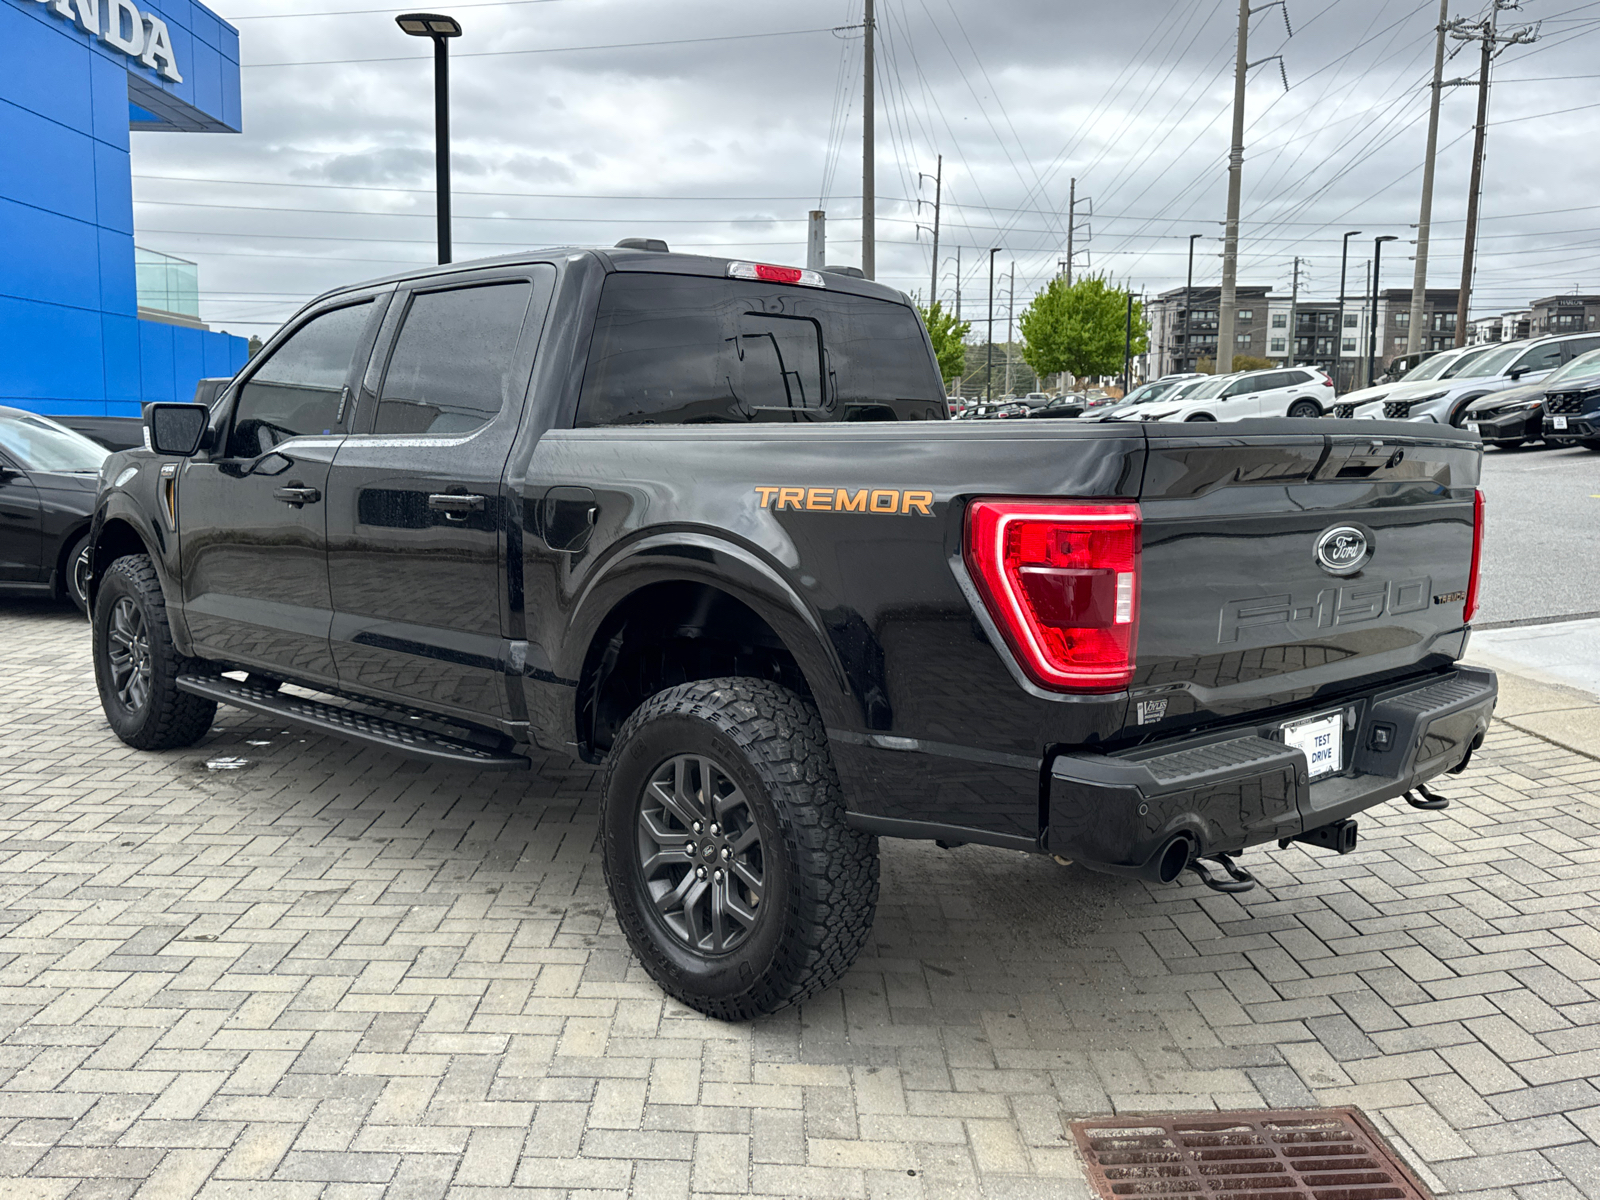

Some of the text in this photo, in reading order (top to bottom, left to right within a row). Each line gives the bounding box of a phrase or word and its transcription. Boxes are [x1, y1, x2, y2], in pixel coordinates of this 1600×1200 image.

[33, 0, 183, 83] NDA
[754, 486, 935, 516] TREMOR
[1332, 536, 1360, 560] Ford
[1218, 574, 1433, 644] F-150
[1314, 733, 1331, 747] TEST
[1312, 748, 1332, 763] DRIVE
